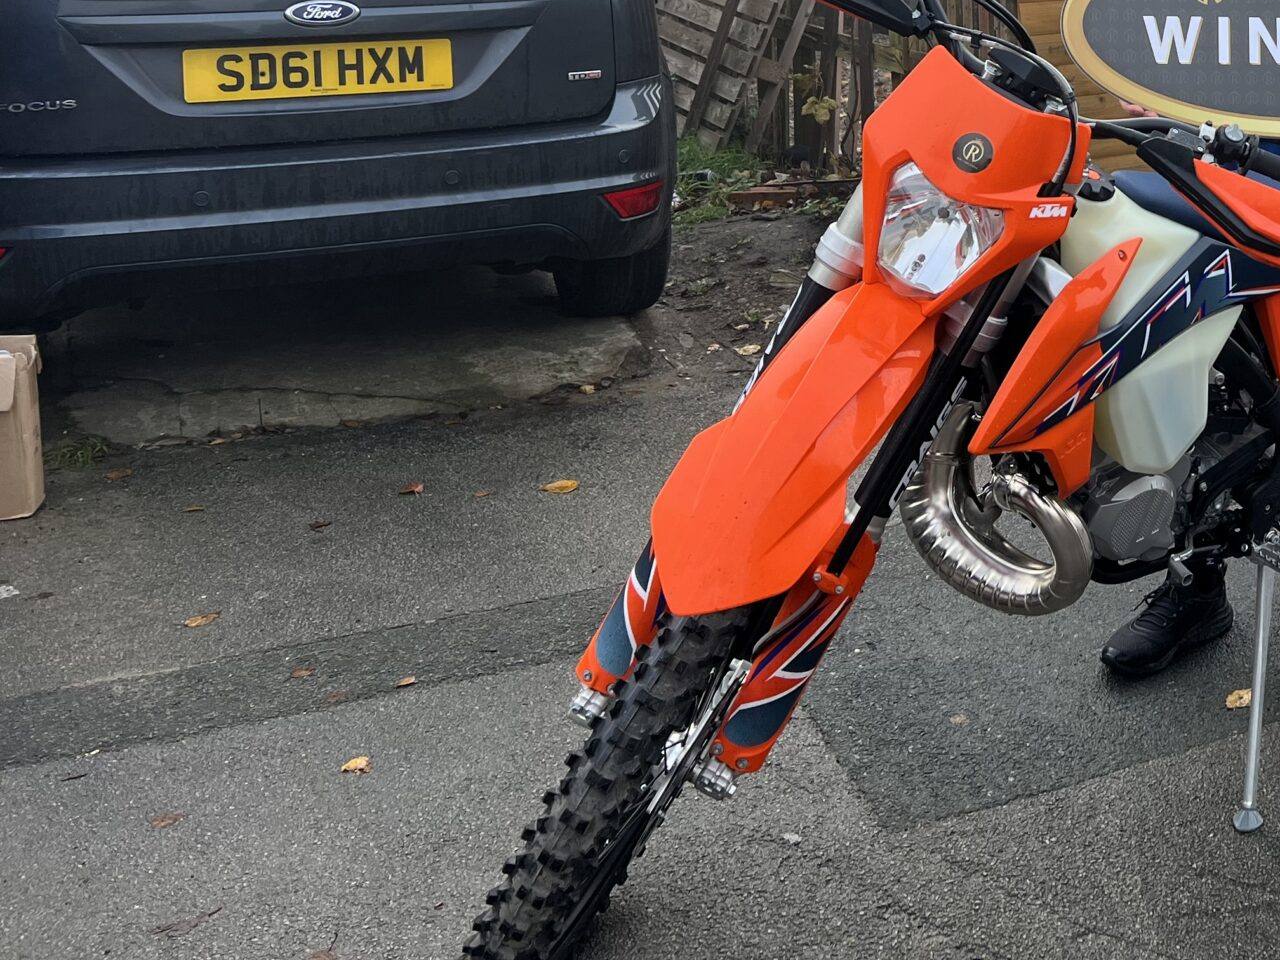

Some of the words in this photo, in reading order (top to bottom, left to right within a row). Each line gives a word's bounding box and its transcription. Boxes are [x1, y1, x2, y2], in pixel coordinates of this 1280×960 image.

[303, 5, 343, 19] Ford
[216, 50, 322, 93] SD61
[337, 46, 424, 86] HXM
[1029, 203, 1068, 218] KTM
